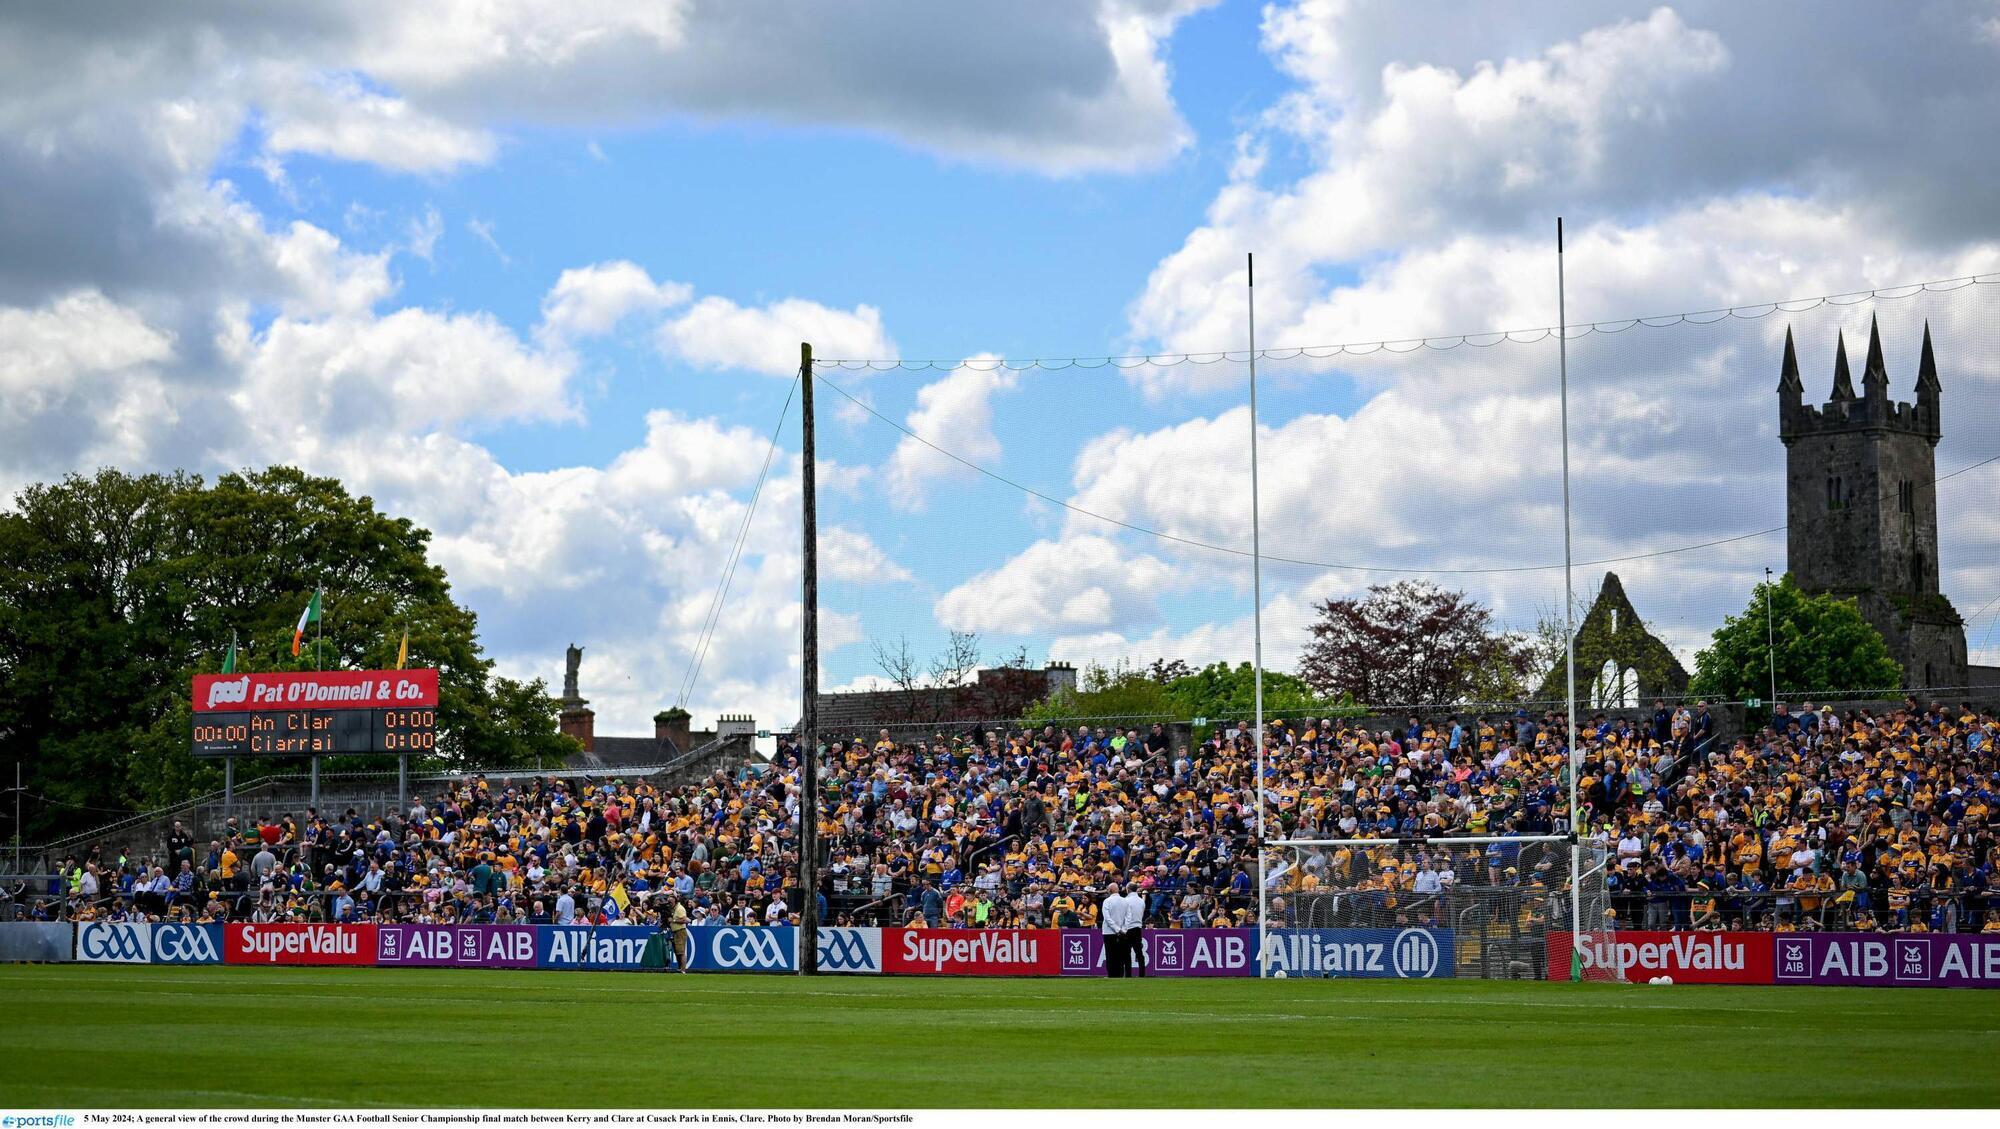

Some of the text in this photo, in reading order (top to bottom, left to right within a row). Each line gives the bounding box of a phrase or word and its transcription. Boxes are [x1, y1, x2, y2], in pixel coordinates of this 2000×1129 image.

[253, 679, 424, 703] Pat O'Donnell & Co.
[251, 713, 333, 731] An Clar
[385, 711, 434, 728] 0:00
[194, 725, 247, 742] 00:00
[251, 735, 332, 752] Ciarrai
[385, 732, 434, 749] 0:00
[82, 924, 146, 960] GAA
[154, 925, 219, 961] GAA
[242, 926, 357, 961] SuperValu
[383, 947, 396, 956] AIB
[406, 931, 453, 960] AIB
[463, 948, 476, 957] AIB
[487, 932, 534, 961] AIB
[712, 928, 788, 968] GAA
[903, 930, 1037, 971] SuperValu
[1190, 937, 1246, 968] AIB
[1265, 934, 1384, 971] Allianz
[1068, 955, 1084, 965] AIB
[1162, 956, 1177, 965] AIB
[1578, 934, 1745, 979] SuperValu
[1785, 962, 1804, 973] AIB
[1820, 941, 1888, 977] AIB
[1903, 963, 1923, 974] AIB
